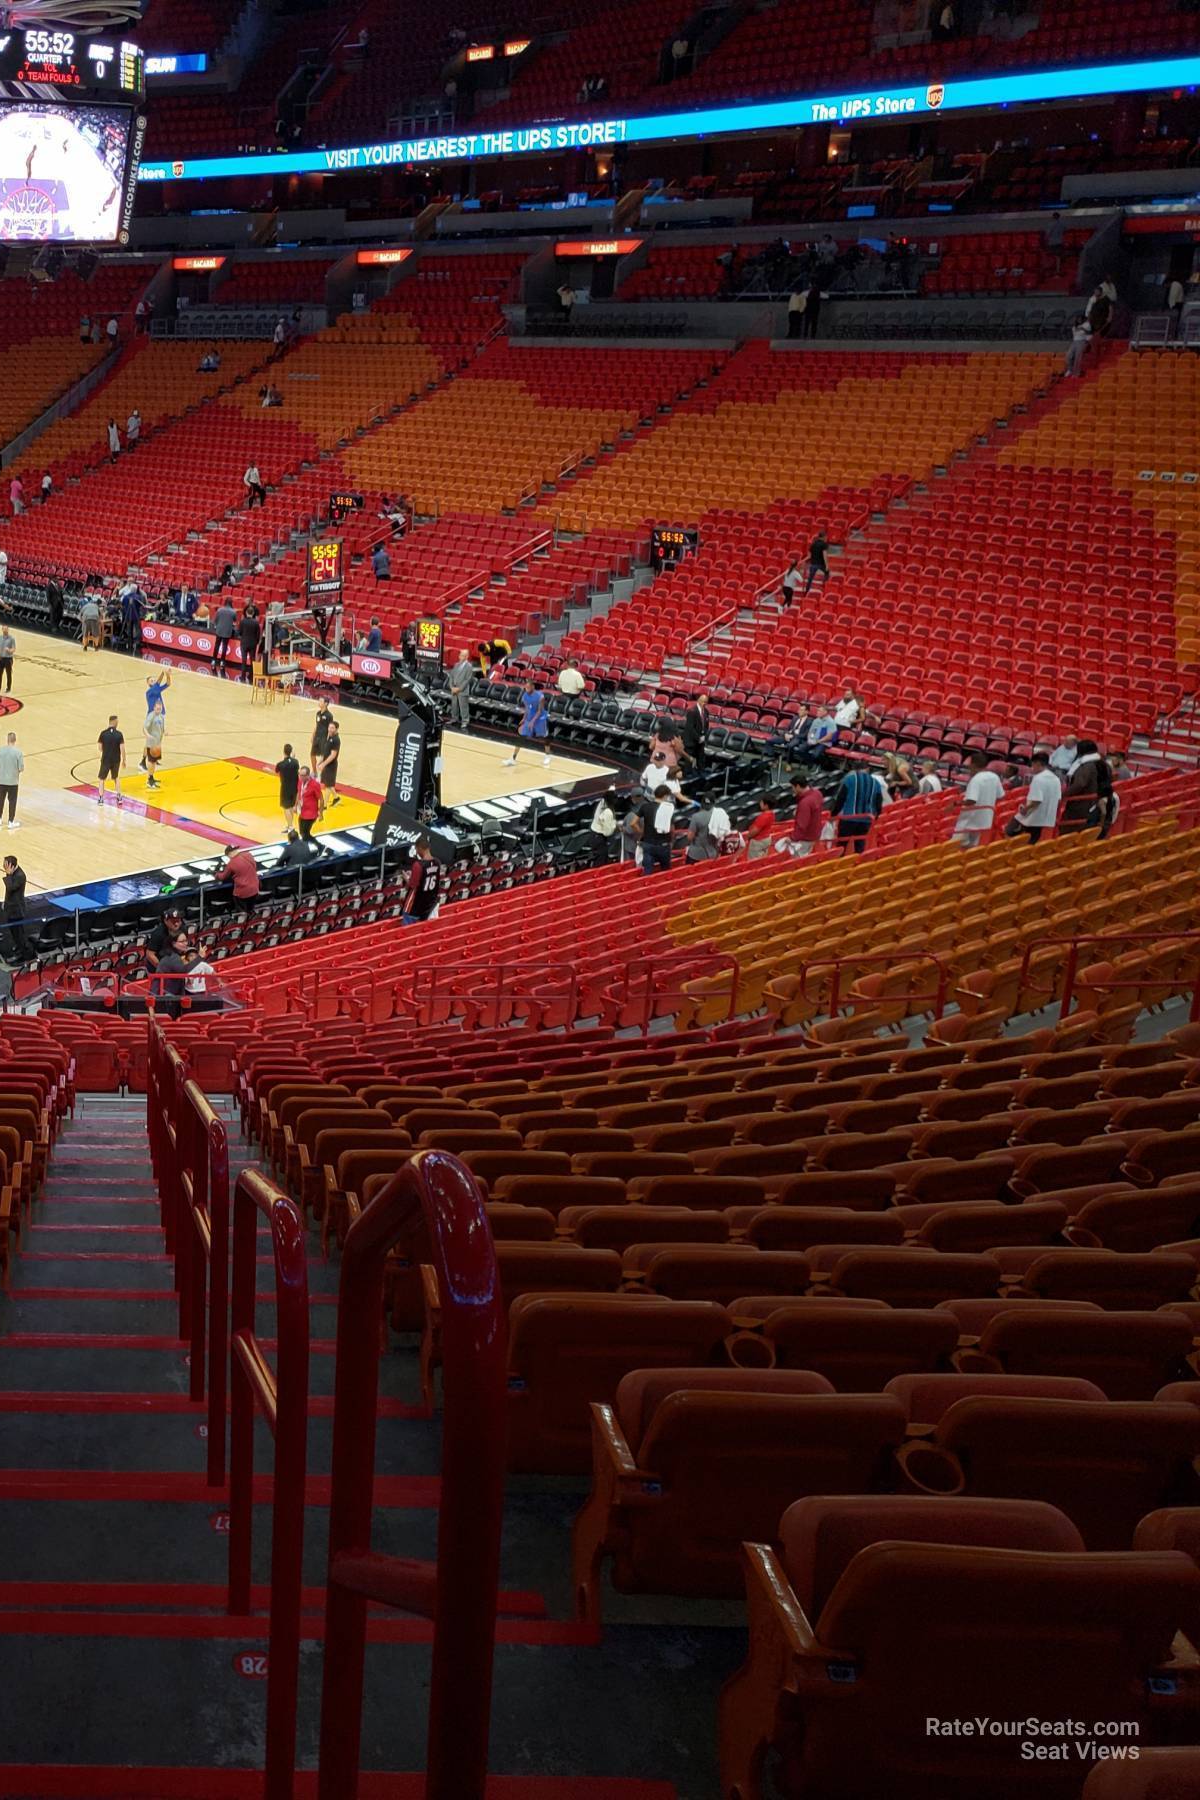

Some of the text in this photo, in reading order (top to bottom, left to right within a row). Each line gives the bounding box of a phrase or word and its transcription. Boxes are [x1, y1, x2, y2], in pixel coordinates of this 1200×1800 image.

[25, 31, 74, 54] 55:52
[27, 53, 62, 63] QUARTER
[43, 64, 57, 72] TOL
[96, 61, 105, 78] 0
[28, 72, 50, 81] TEAM
[50, 73, 72, 83] FOULS
[811, 97, 916, 120] The UPS Store
[326, 148, 360, 168] VISIT
[362, 145, 403, 164] YOUR
[406, 137, 475, 161] NEAREST
[481, 132, 513, 154] THE
[518, 128, 552, 150] UPS
[122, 131, 144, 230] MICCOSUKEE.COM
[137, 167, 166, 180] Store
[661, 531, 684, 543] 55:52
[312, 544, 338, 560] 55:52
[315, 559, 335, 580] 24
[319, 582, 341, 591] TISSOT
[423, 635, 436, 648] 24
[395, 743, 404, 788] SOFTWARE
[399, 733, 421, 802] Ultimate
[386, 824, 422, 843] Florid
[424, 875, 437, 891] 16
[241, 1655, 267, 1674] 28
